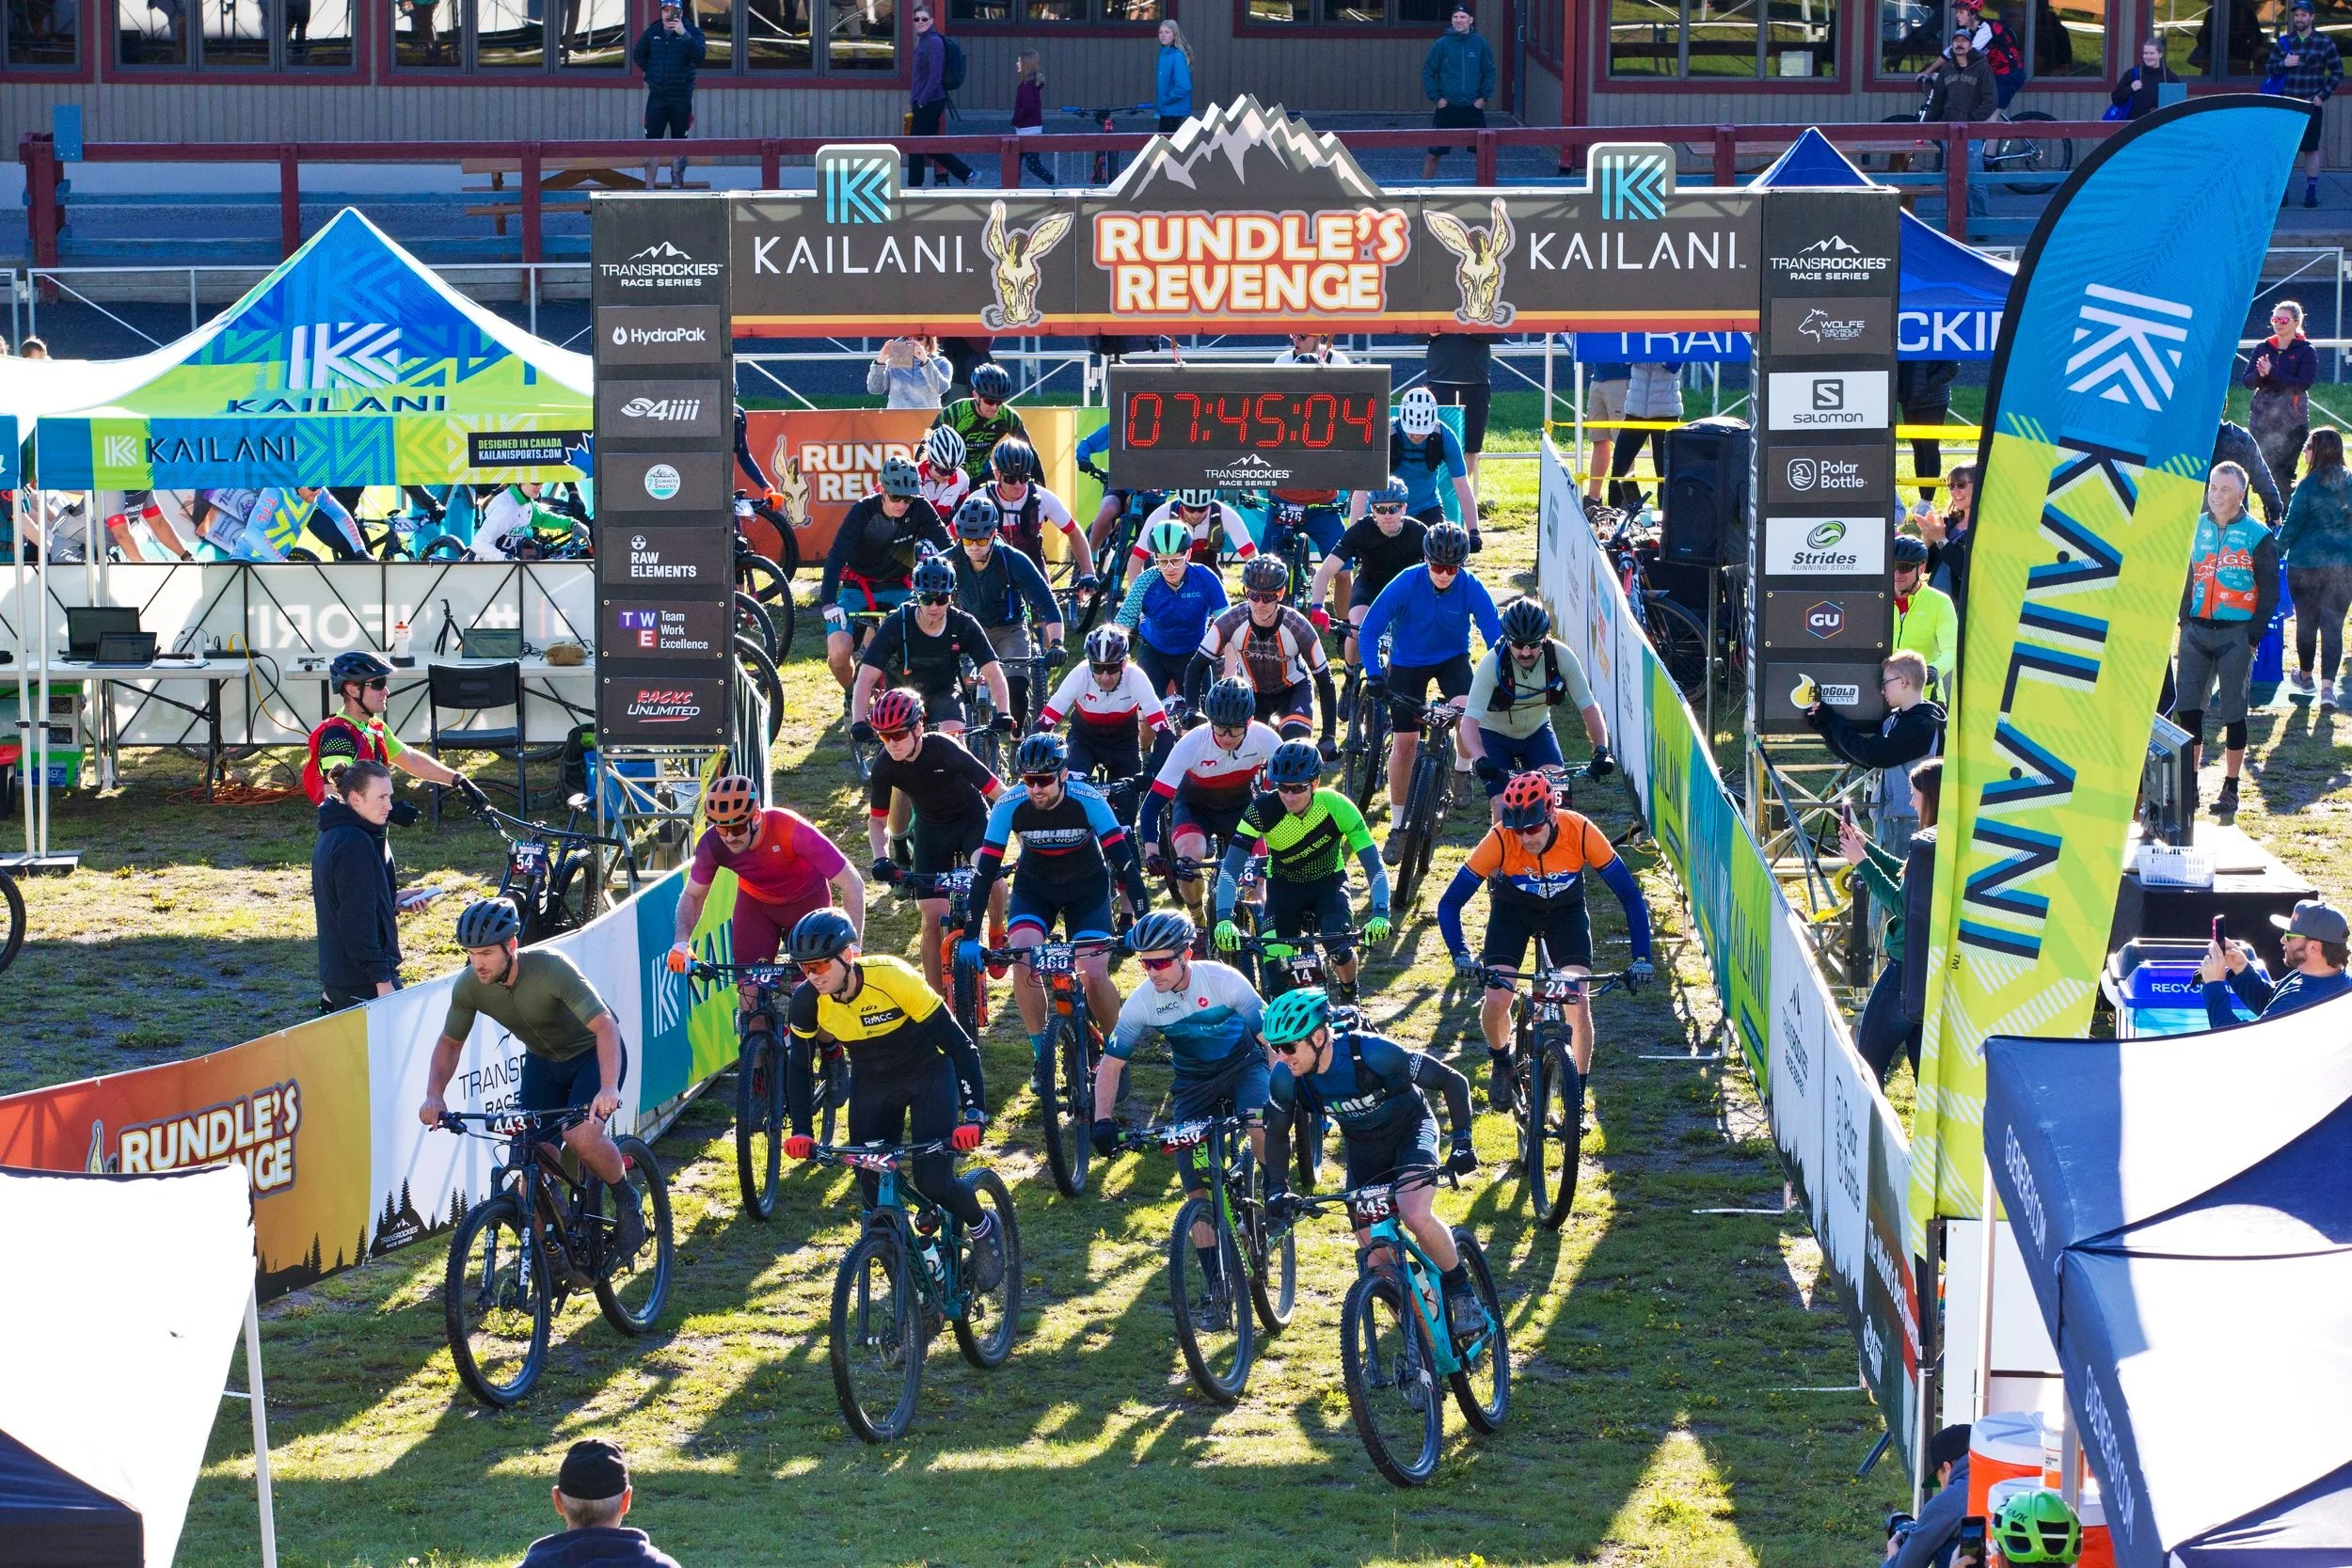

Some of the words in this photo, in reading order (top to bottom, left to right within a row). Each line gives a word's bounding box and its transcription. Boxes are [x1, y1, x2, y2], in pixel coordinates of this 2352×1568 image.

[1100, 214, 1408, 262] RUNDLE'S
[755, 235, 963, 274] KAILANI
[1530, 231, 1736, 270] KAILANI
[599, 263, 720, 277] TRANSROCKIES
[1770, 257, 1887, 270] TRANSROCKIES
[621, 278, 654, 287] RACE
[657, 278, 702, 287] SERIES
[1789, 272, 1822, 280] RACE
[1825, 272, 1870, 280] SERIES
[1117, 263, 1381, 310] REVENGE
[1820, 320, 1866, 328] WOLFE
[630, 326, 706, 346] HydraPak
[227, 395, 450, 414] KAILANI
[646, 399, 701, 420] 4iiii
[1127, 392, 1375, 448] 07:45:04
[1792, 412, 1864, 423] salomon
[145, 435, 299, 464] KAILANI
[478, 438, 518, 450] DESIGNED
[519, 438, 529, 449] IN
[530, 437, 563, 448] CANADA
[478, 449, 563, 460] KAILANISPORTS.COM
[1820, 460, 1859, 474] Polar
[1204, 469, 1290, 480] TRANSROCKIES
[1820, 474, 1865, 488] Bottle
[631, 551, 660, 564] RAW
[1792, 551, 1857, 564] Strides
[631, 565, 697, 578] ELEMENTS
[660, 610, 685, 622] Team
[1809, 613, 1840, 627] GU
[660, 625, 685, 636] Work
[660, 638, 708, 650] Excellence
[636, 689, 693, 705] RACKS
[1957, 426, 2151, 971] KAILANI
[627, 704, 700, 716] UNLIMITED
[516, 854, 534, 870] 54
[1291, 968, 1313, 984] 14
[1545, 981, 1567, 998] 24
[863, 1012, 895, 1026] RMCC
[120, 1085, 298, 1174] RUNDLE'S
[493, 1115, 528, 1134] 443
[2005, 1124, 2046, 1260] GUENERGY.COM
[1356, 1197, 1391, 1216] 445
[2085, 1364, 2136, 1544] GUENERGY.COM
